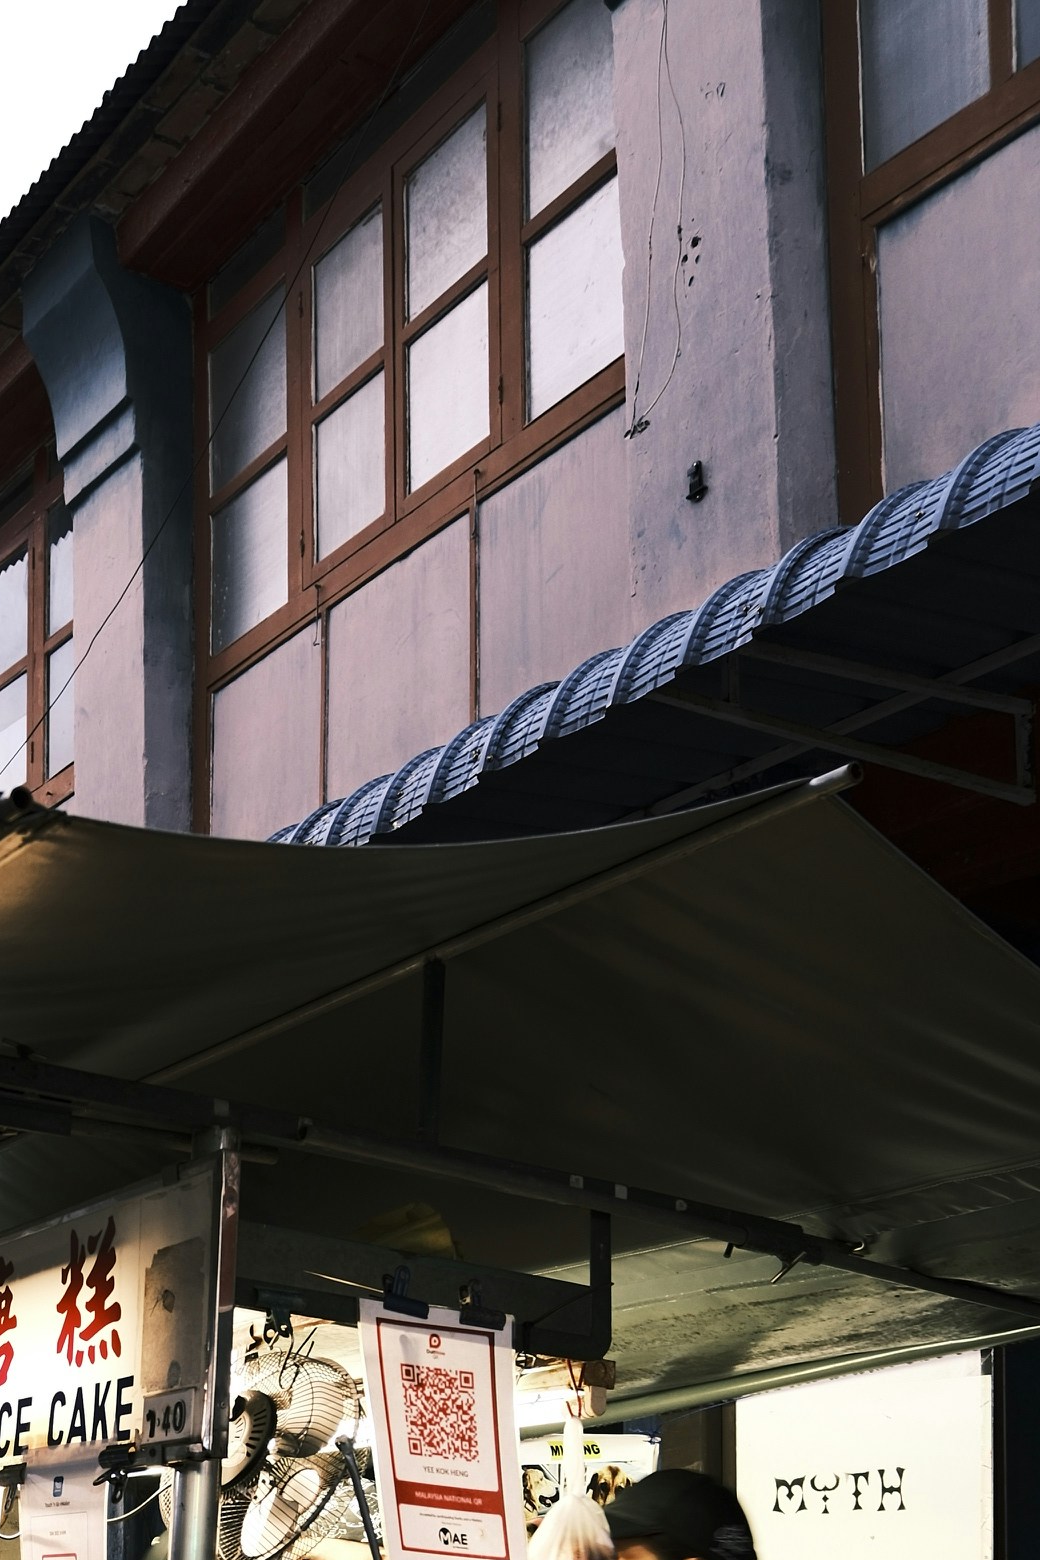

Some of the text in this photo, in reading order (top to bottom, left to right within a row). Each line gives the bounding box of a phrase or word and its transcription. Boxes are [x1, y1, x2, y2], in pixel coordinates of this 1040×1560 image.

[48, 1376, 134, 1446] CAKE
[423, 1466, 434, 1474] YEE
[451, 1470, 468, 1478] HENG
[415, 1491, 442, 1500] MALAYSIA
[444, 1494, 472, 1504] NATIONAL
[772, 1467, 906, 1514] MYTH
